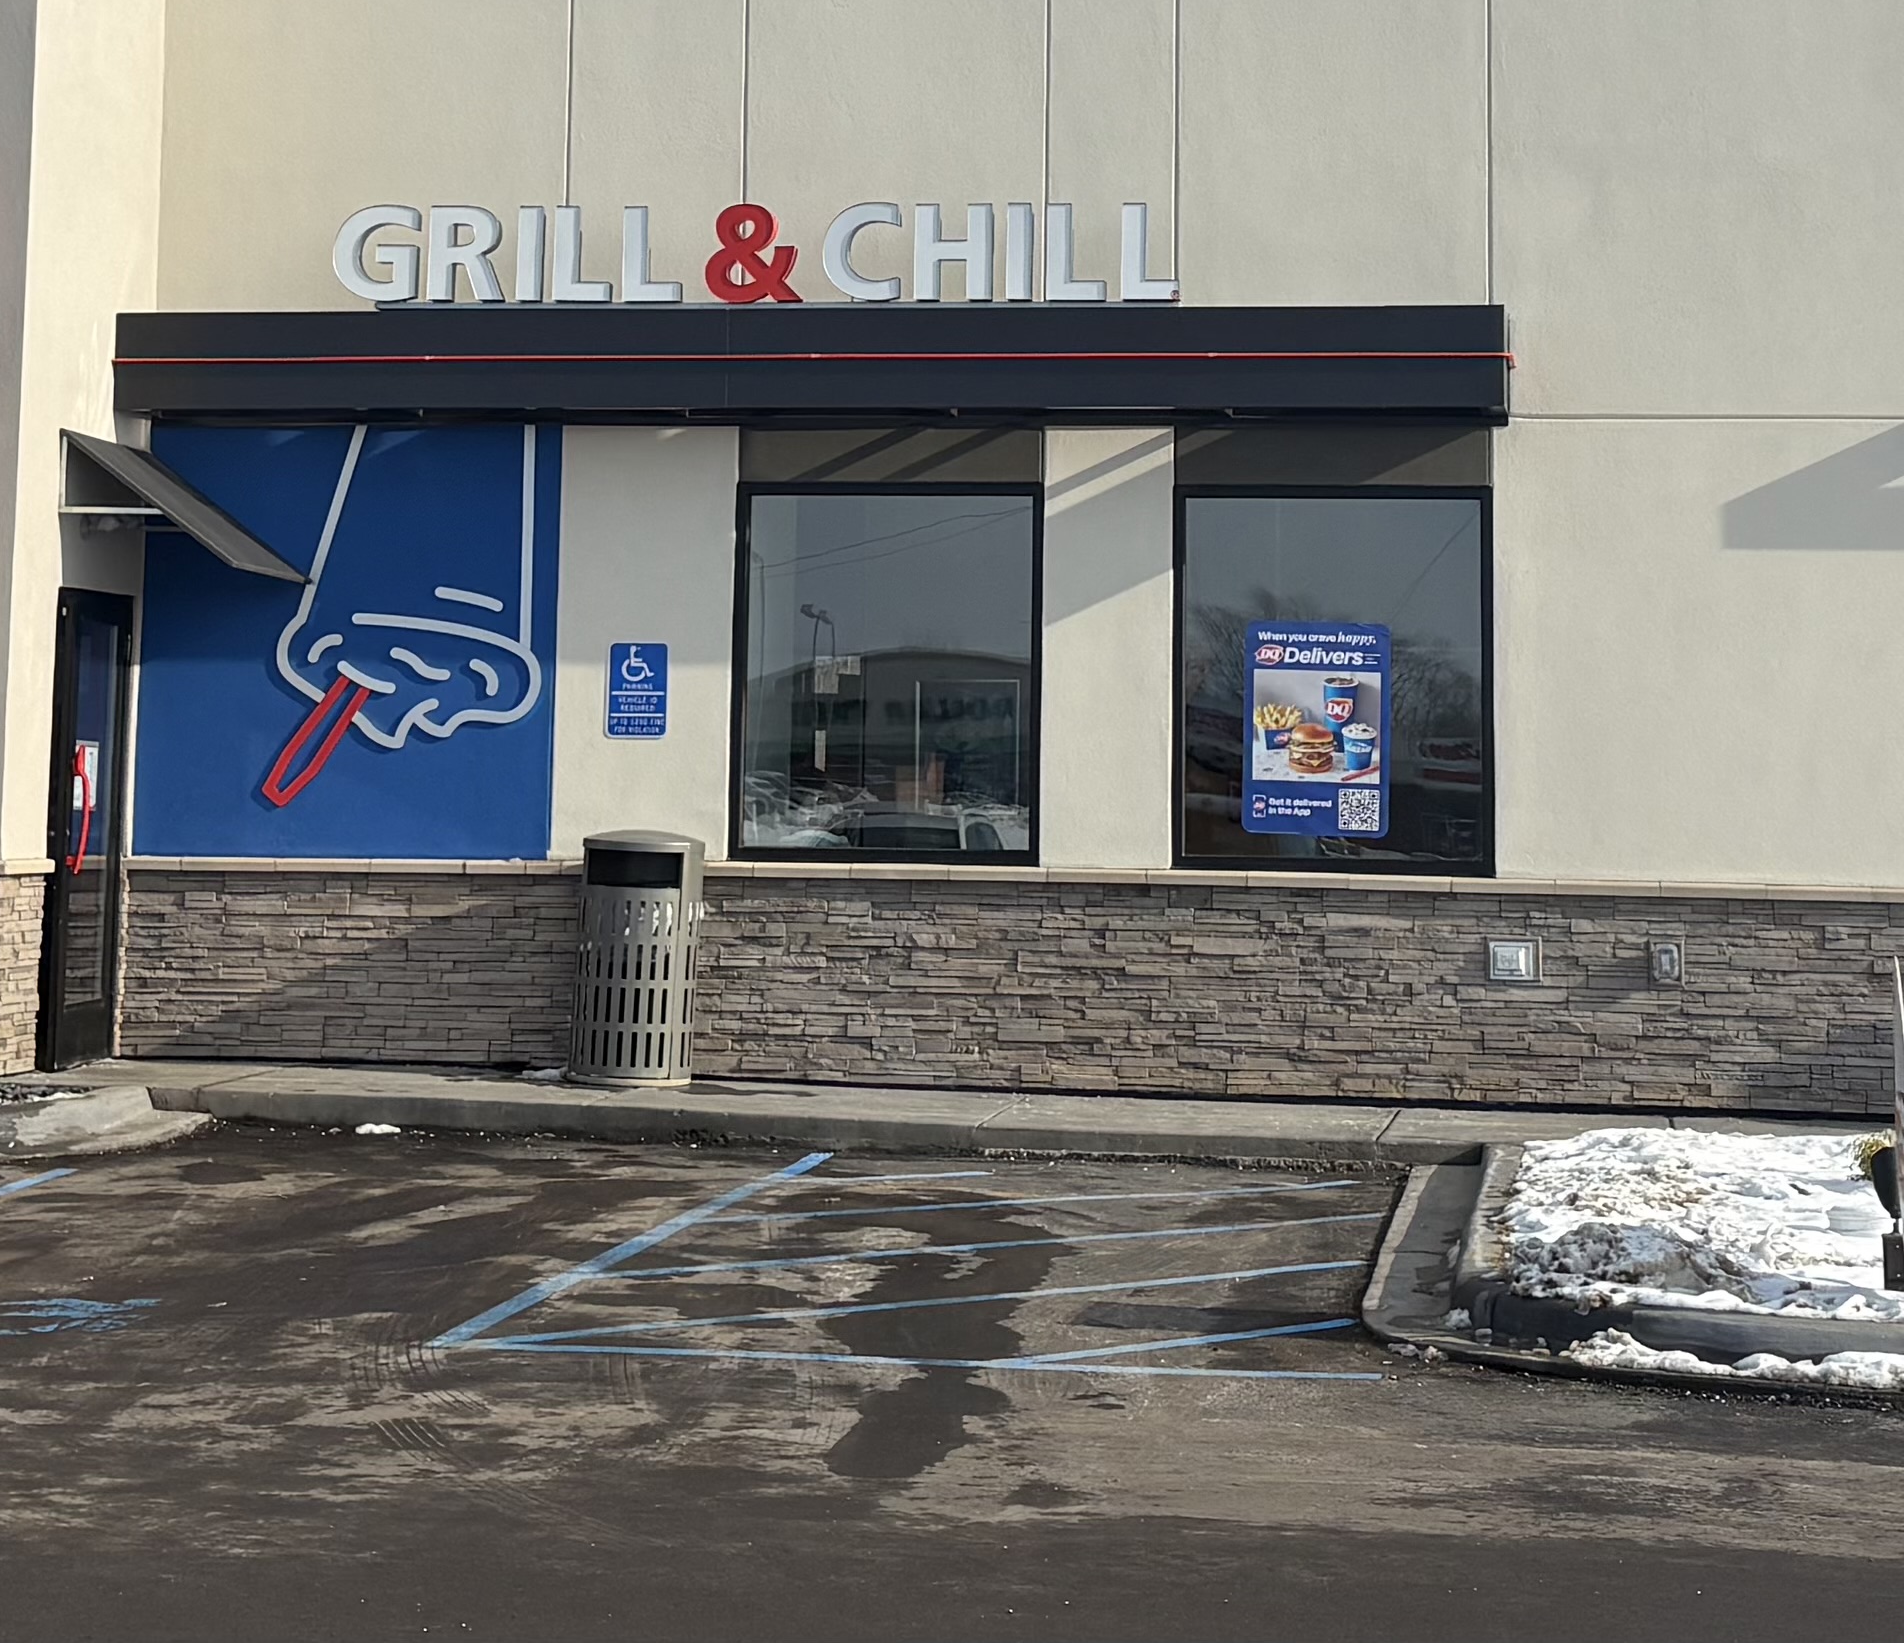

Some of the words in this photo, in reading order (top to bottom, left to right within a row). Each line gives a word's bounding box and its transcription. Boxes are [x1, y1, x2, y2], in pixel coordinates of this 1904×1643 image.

[333, 204, 684, 303] GRILL
[704, 203, 804, 303] &
[822, 202, 1179, 303] CHILL
[1258, 631, 1287, 641] When
[1288, 633, 1307, 643] you
[1260, 648, 1281, 660] DQ
[1283, 647, 1364, 666] Delivers
[1326, 702, 1350, 715] DQ
